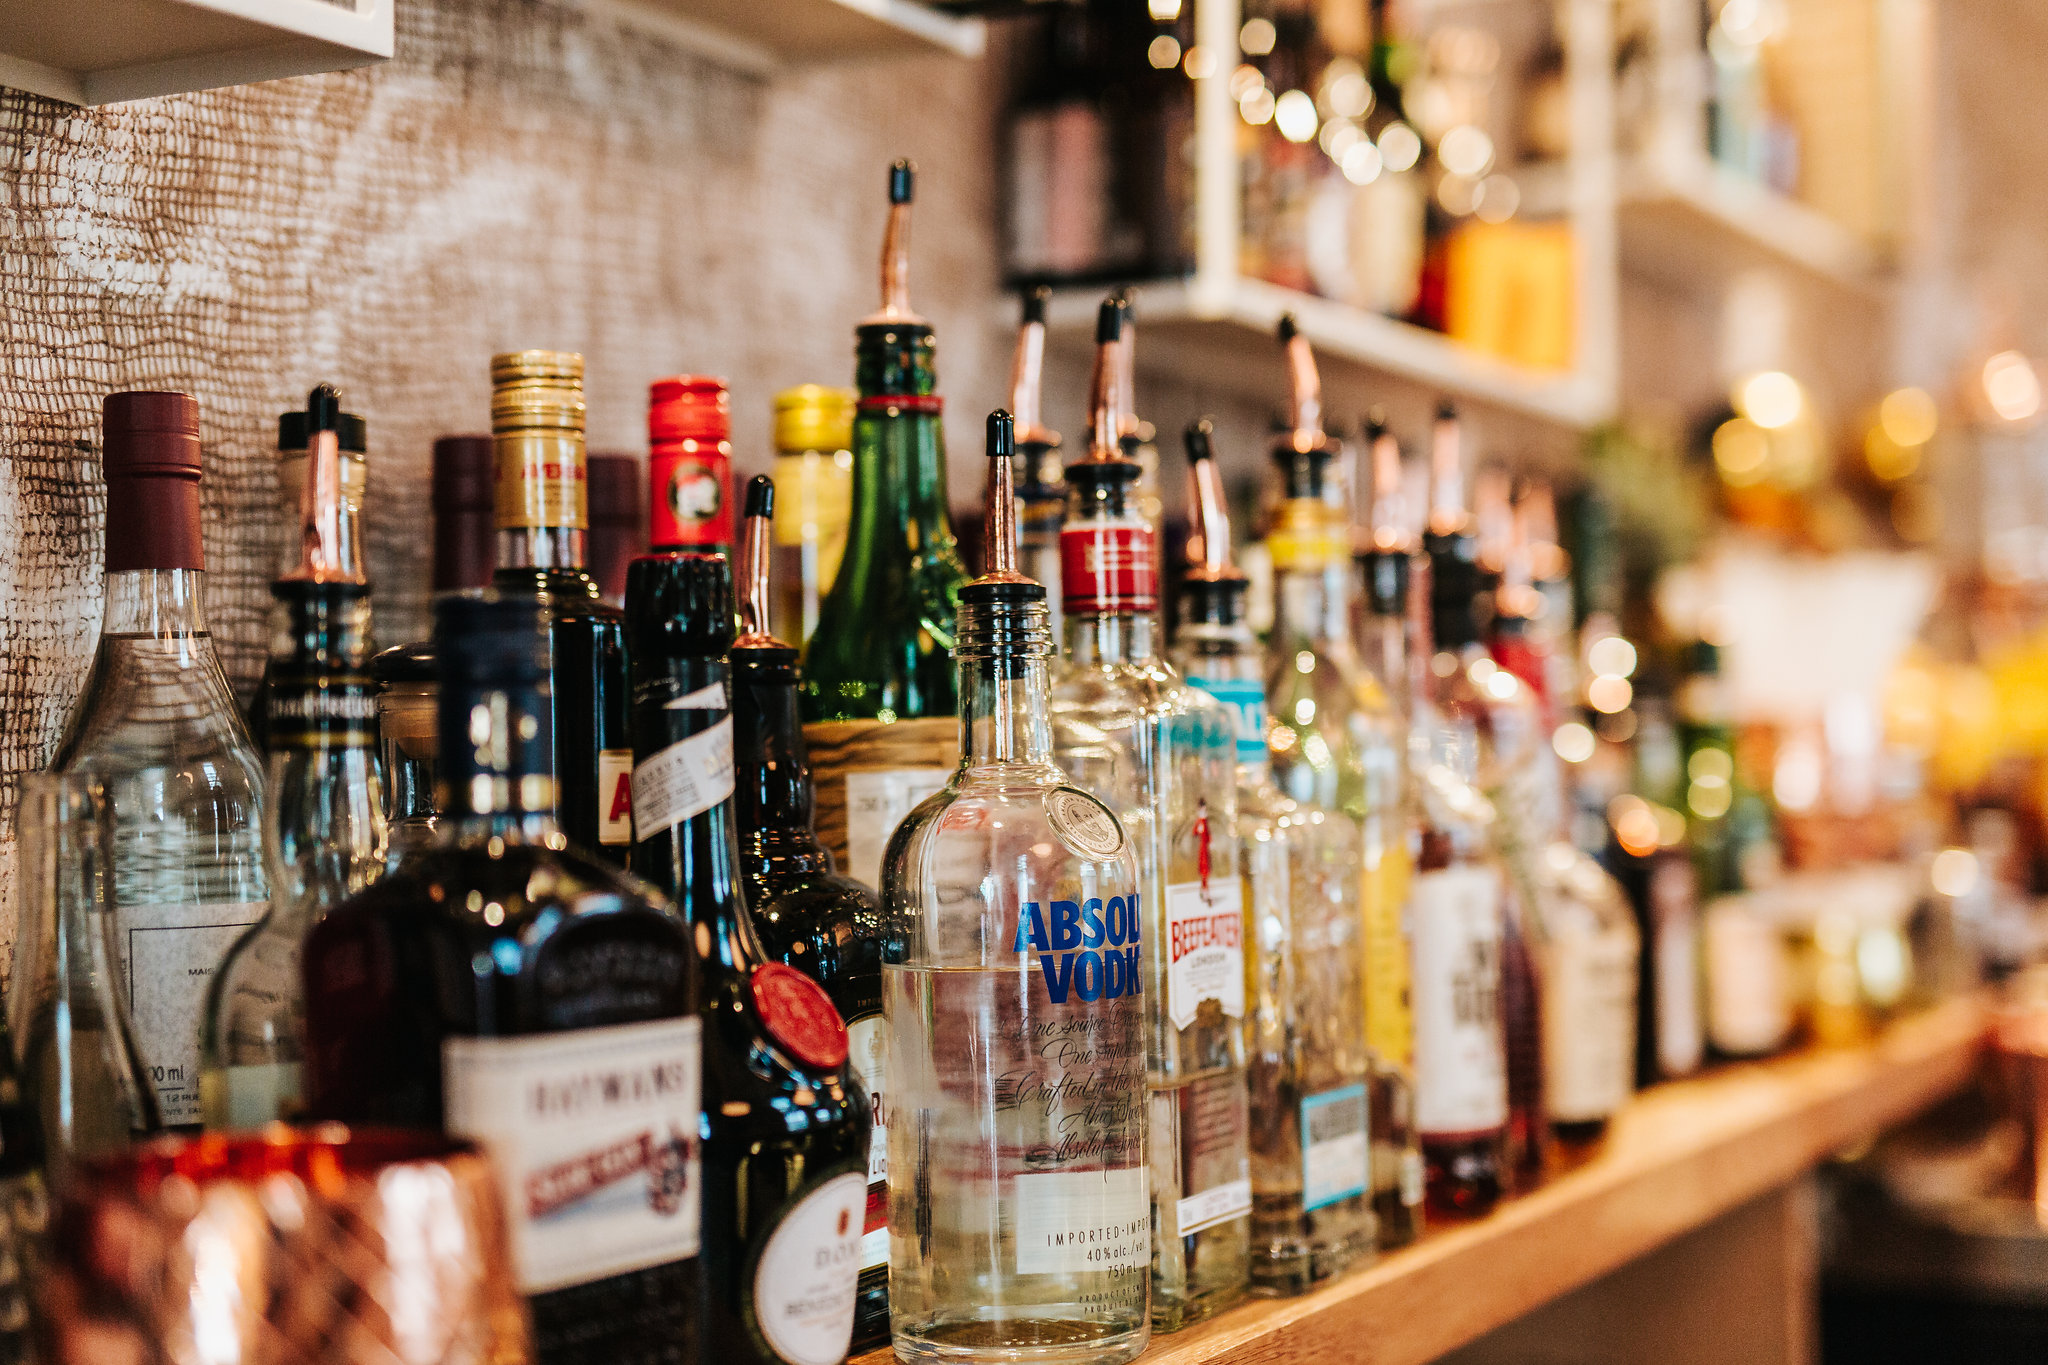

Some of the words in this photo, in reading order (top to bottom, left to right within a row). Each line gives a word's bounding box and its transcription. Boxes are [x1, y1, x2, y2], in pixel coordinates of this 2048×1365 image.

[1171, 910, 1242, 964] BEEFEATER
[1041, 1037, 1092, 1069] One
[996, 1069, 1094, 1117] Crafted
[1079, 1289, 1119, 1303] PRODUCT
[1084, 1299, 1123, 1315] PRODUIT
